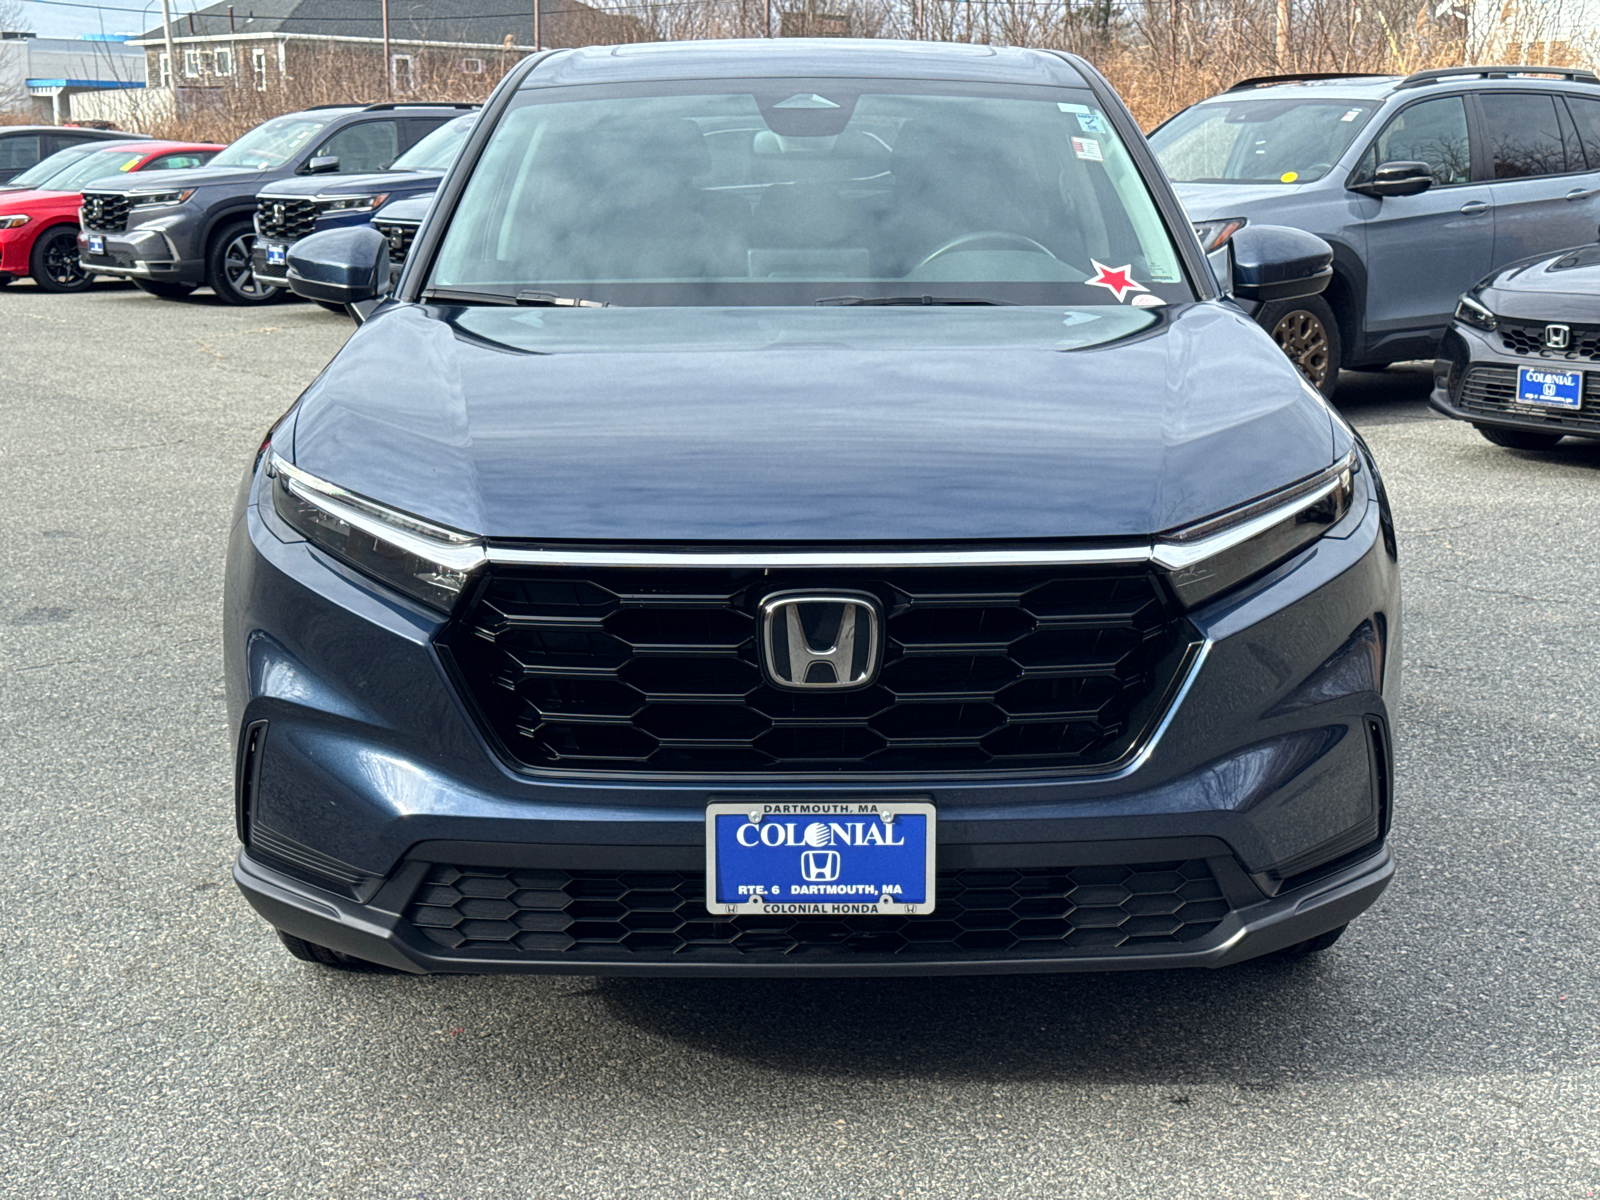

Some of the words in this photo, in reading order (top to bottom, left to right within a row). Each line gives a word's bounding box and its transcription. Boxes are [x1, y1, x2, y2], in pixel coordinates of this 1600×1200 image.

[1526, 372, 1575, 386] COLONIAL
[763, 804, 854, 813] DARTMOUTH,
[858, 804, 879, 813] MA
[736, 822, 905, 848] COLONIAL
[738, 885, 769, 895] RTE.
[771, 885, 780, 894] 6
[791, 884, 879, 896] DARTMOUTH,
[882, 884, 903, 894] MA
[763, 904, 828, 914] COLONIAL
[831, 904, 879, 914] HONDA
